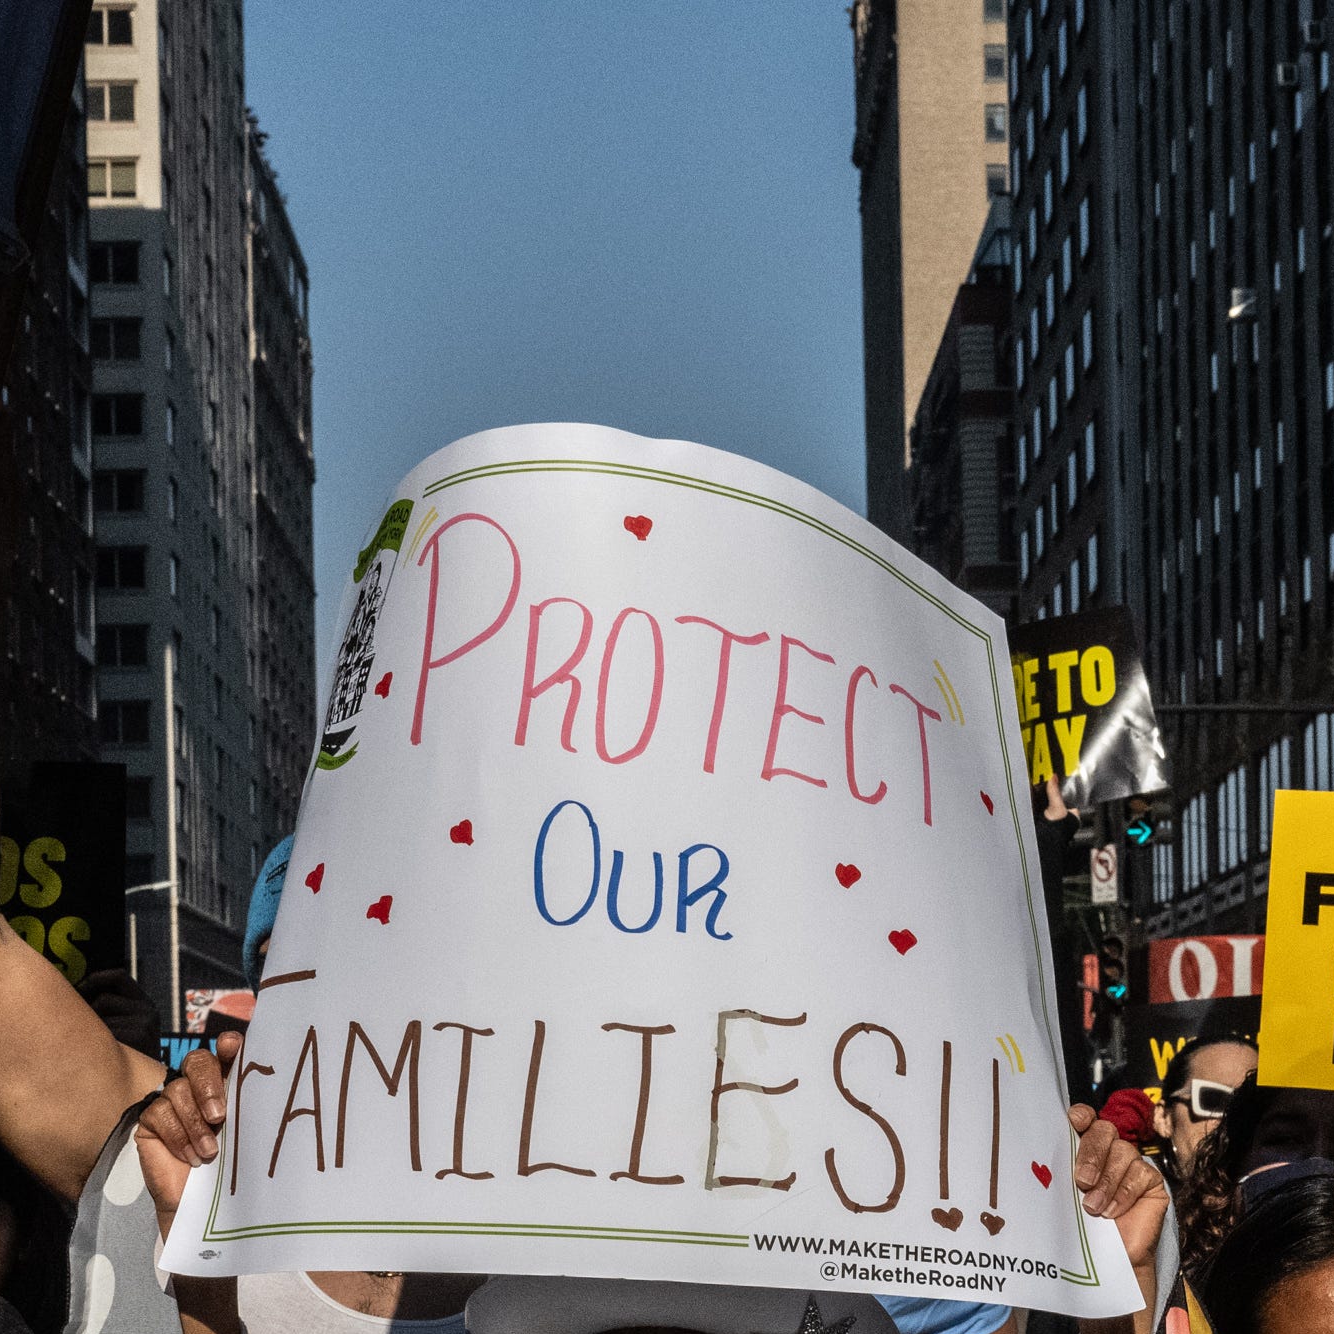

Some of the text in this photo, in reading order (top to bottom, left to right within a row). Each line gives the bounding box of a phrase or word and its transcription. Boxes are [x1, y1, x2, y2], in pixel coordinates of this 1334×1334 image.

[411, 512, 945, 827] PROTECT
[1048, 645, 1116, 714] TO
[533, 800, 734, 941] OUR
[753, 1233, 1058, 1280] WWW.MAKETHEROADNY.ORG
[820, 1261, 1007, 1293] @MaketheRoadNY
